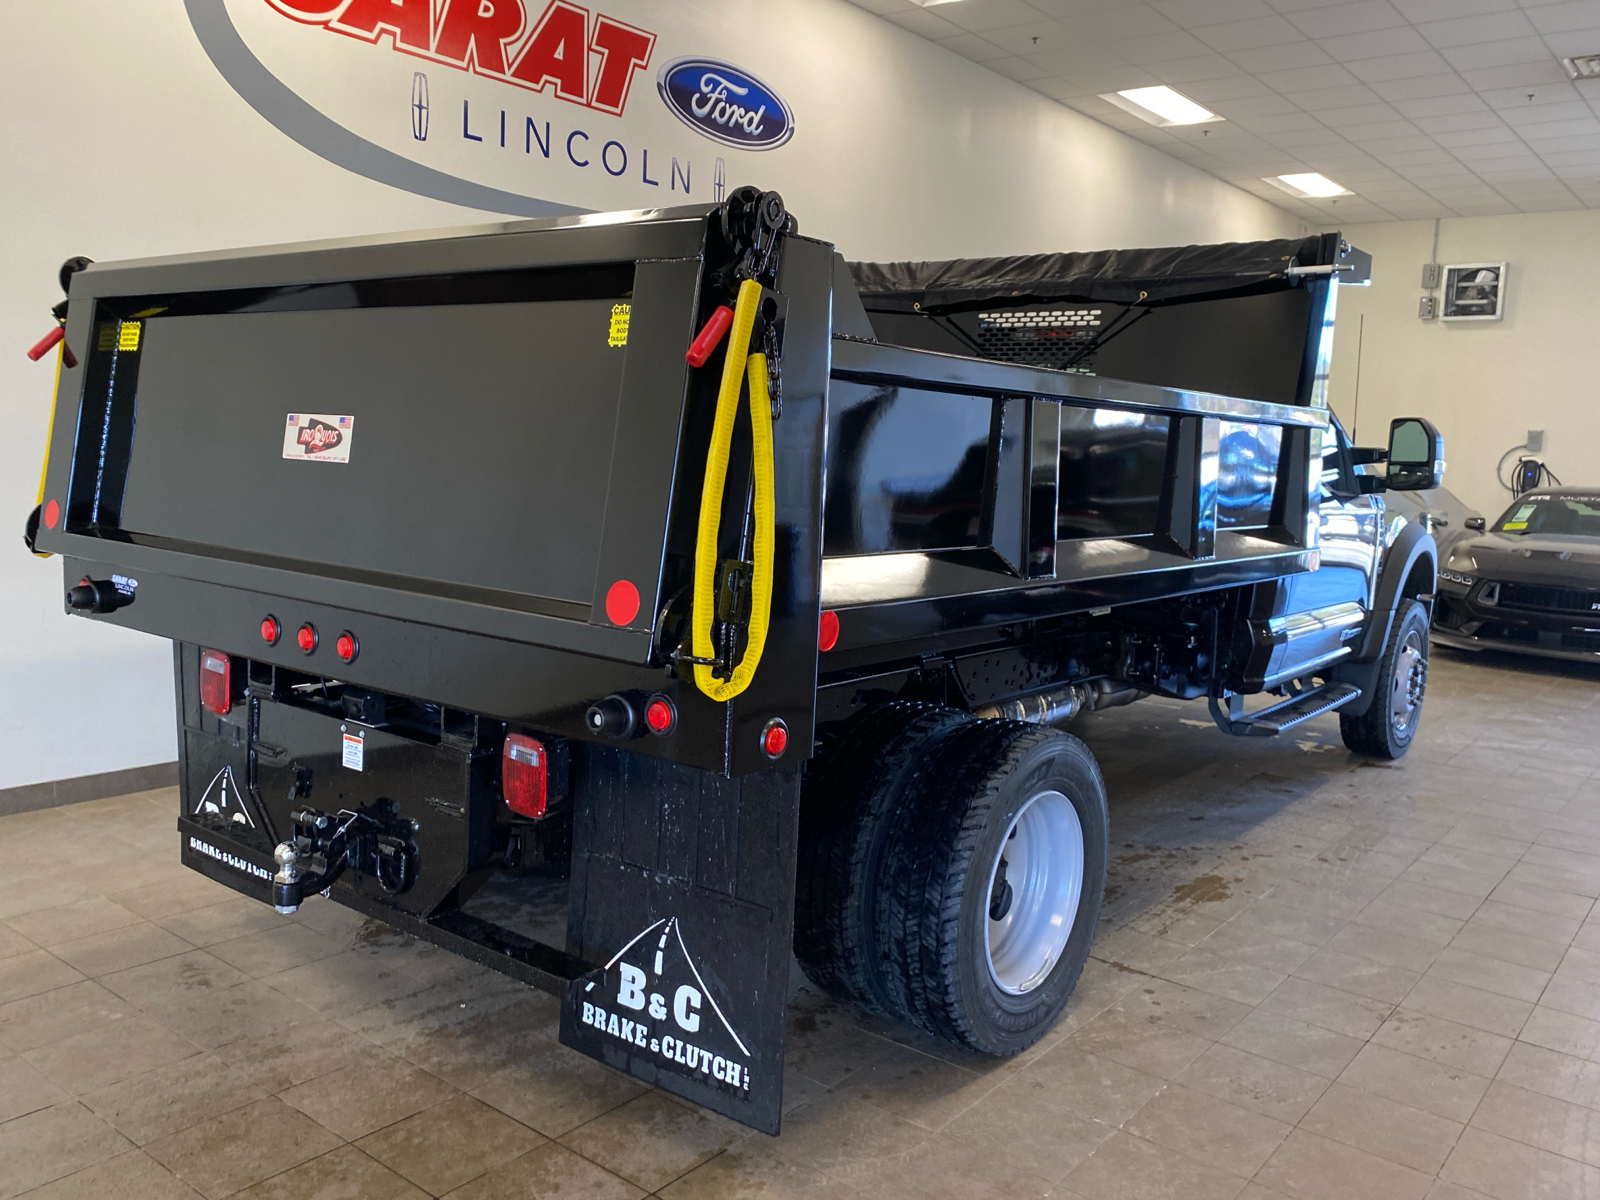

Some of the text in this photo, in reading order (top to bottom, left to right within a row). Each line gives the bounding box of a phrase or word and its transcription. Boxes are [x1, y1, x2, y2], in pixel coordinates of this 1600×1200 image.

[264, 0, 656, 117] ARAT
[463, 100, 691, 194] LINCOLN
[691, 73, 766, 135] Ford
[300, 425, 339, 447] IROQUOIS
[582, 1001, 741, 1087] BRAKE & CLUTCH
